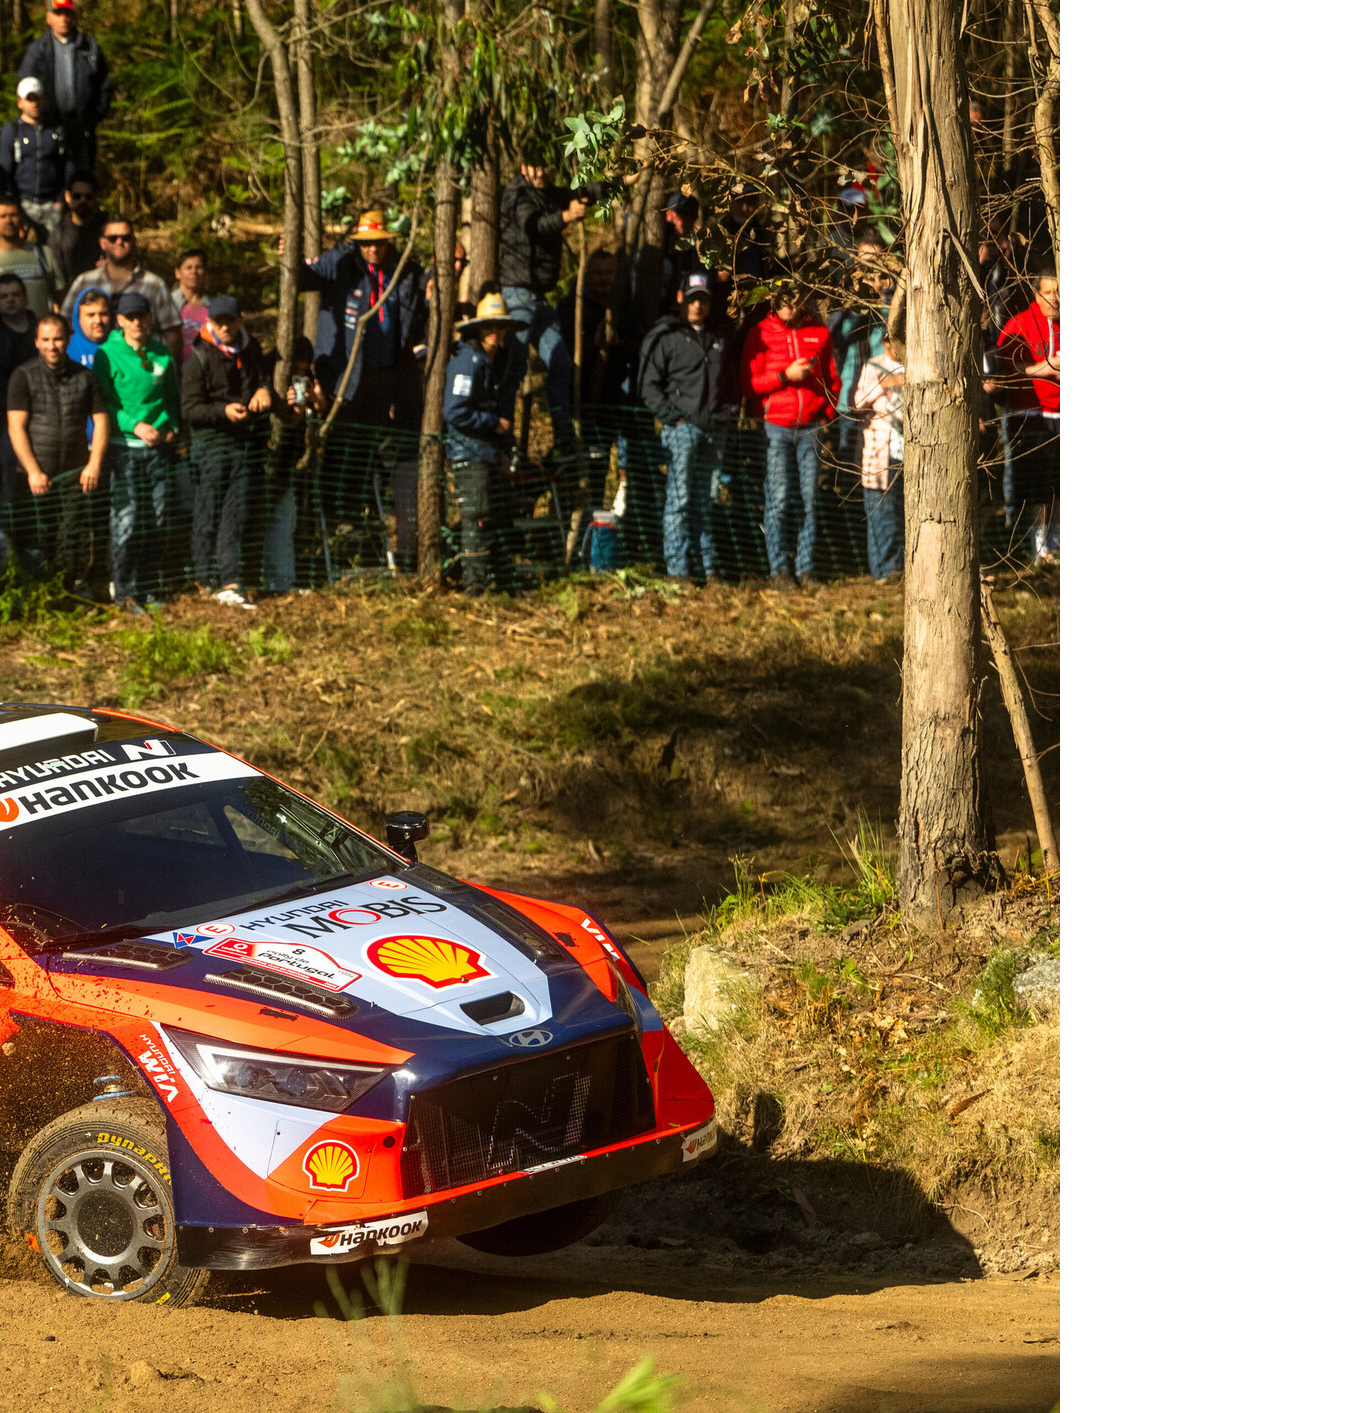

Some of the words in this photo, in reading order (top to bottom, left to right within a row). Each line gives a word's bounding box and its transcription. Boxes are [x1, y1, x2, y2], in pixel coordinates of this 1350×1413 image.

[239, 899, 350, 931] HYUNDAI
[281, 896, 448, 939] MOBIS
[291, 948, 306, 956] 8
[139, 1034, 176, 1075] HYUNDAI
